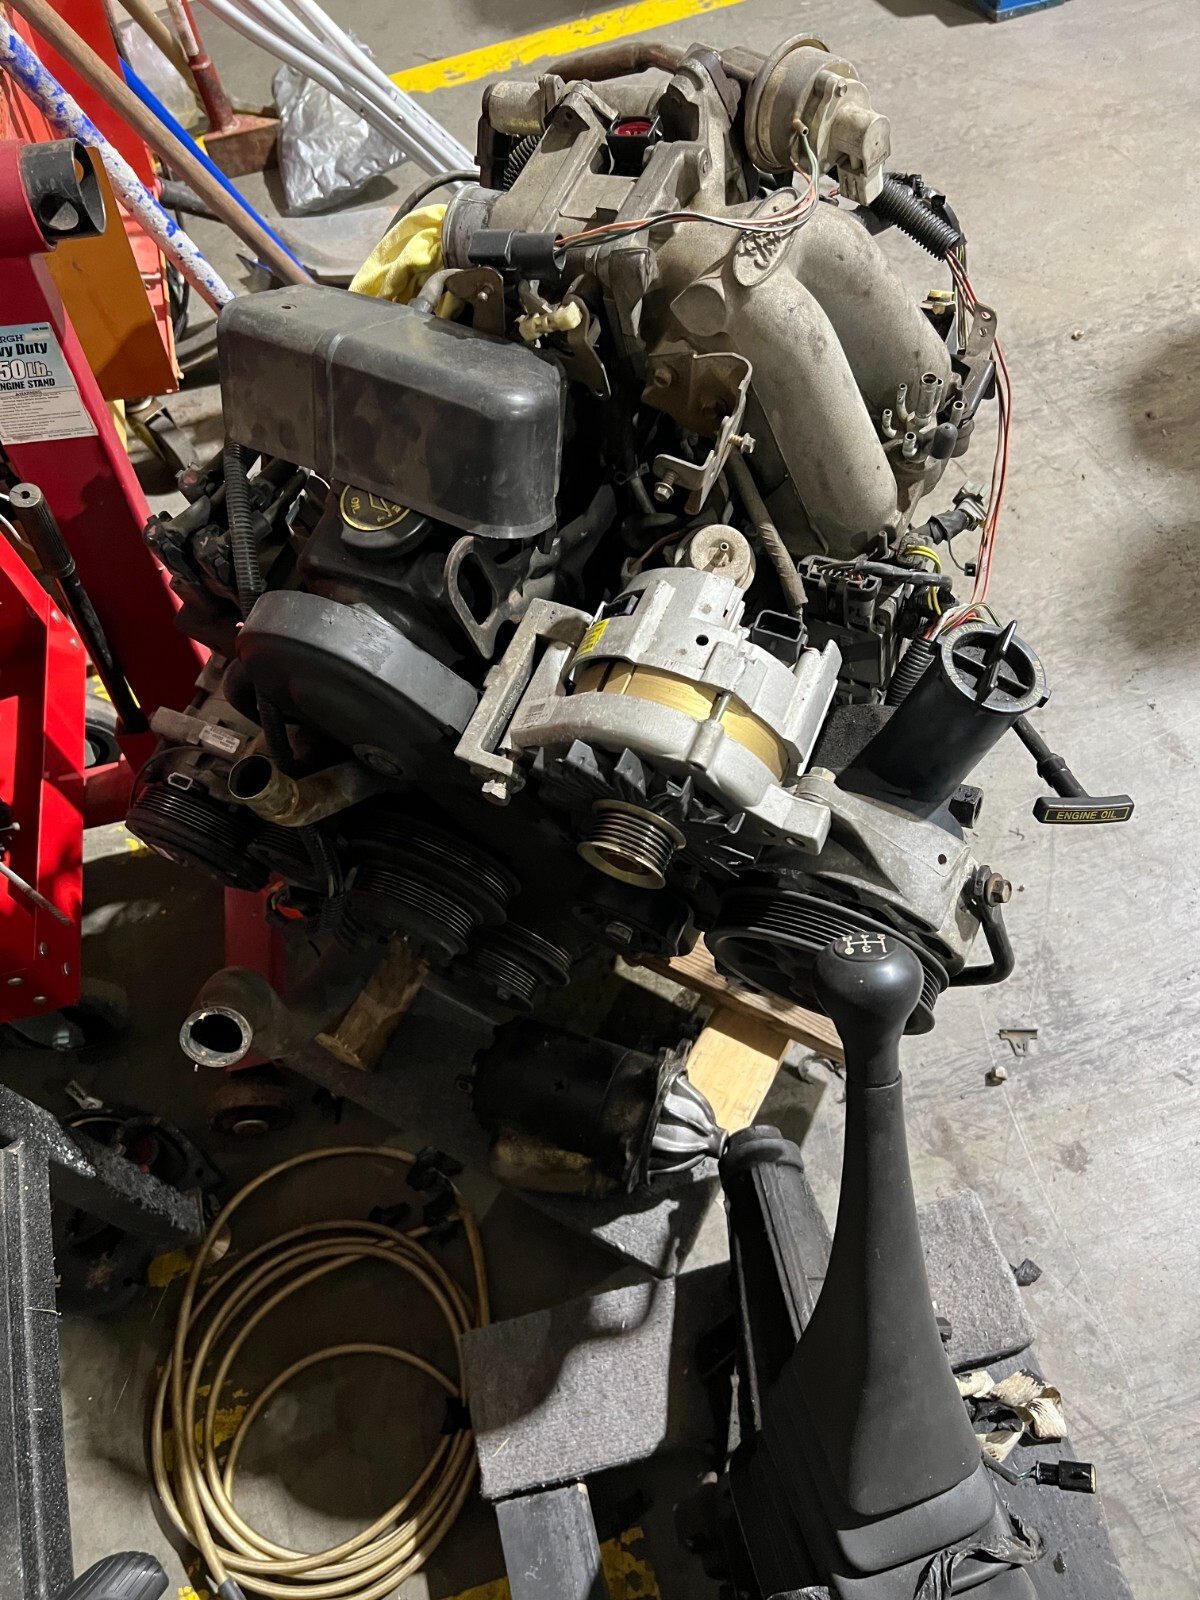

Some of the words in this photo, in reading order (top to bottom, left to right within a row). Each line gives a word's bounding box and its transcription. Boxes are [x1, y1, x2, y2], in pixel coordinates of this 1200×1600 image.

[16, 342, 48, 356] Duty
[0, 359, 26, 381] 50
[26, 361, 52, 378] Lb.
[0, 381, 26, 391] NGINE
[28, 378, 56, 388] STAND
[351, 497, 360, 514] OIL
[962, 624, 983, 632] FLUID
[944, 629, 962, 656] STEERING
[946, 663, 962, 684] POWER
[1056, 811, 1098, 820] ENGINE
[1100, 810, 1117, 819] OIL
[862, 945, 872, 953] 3
